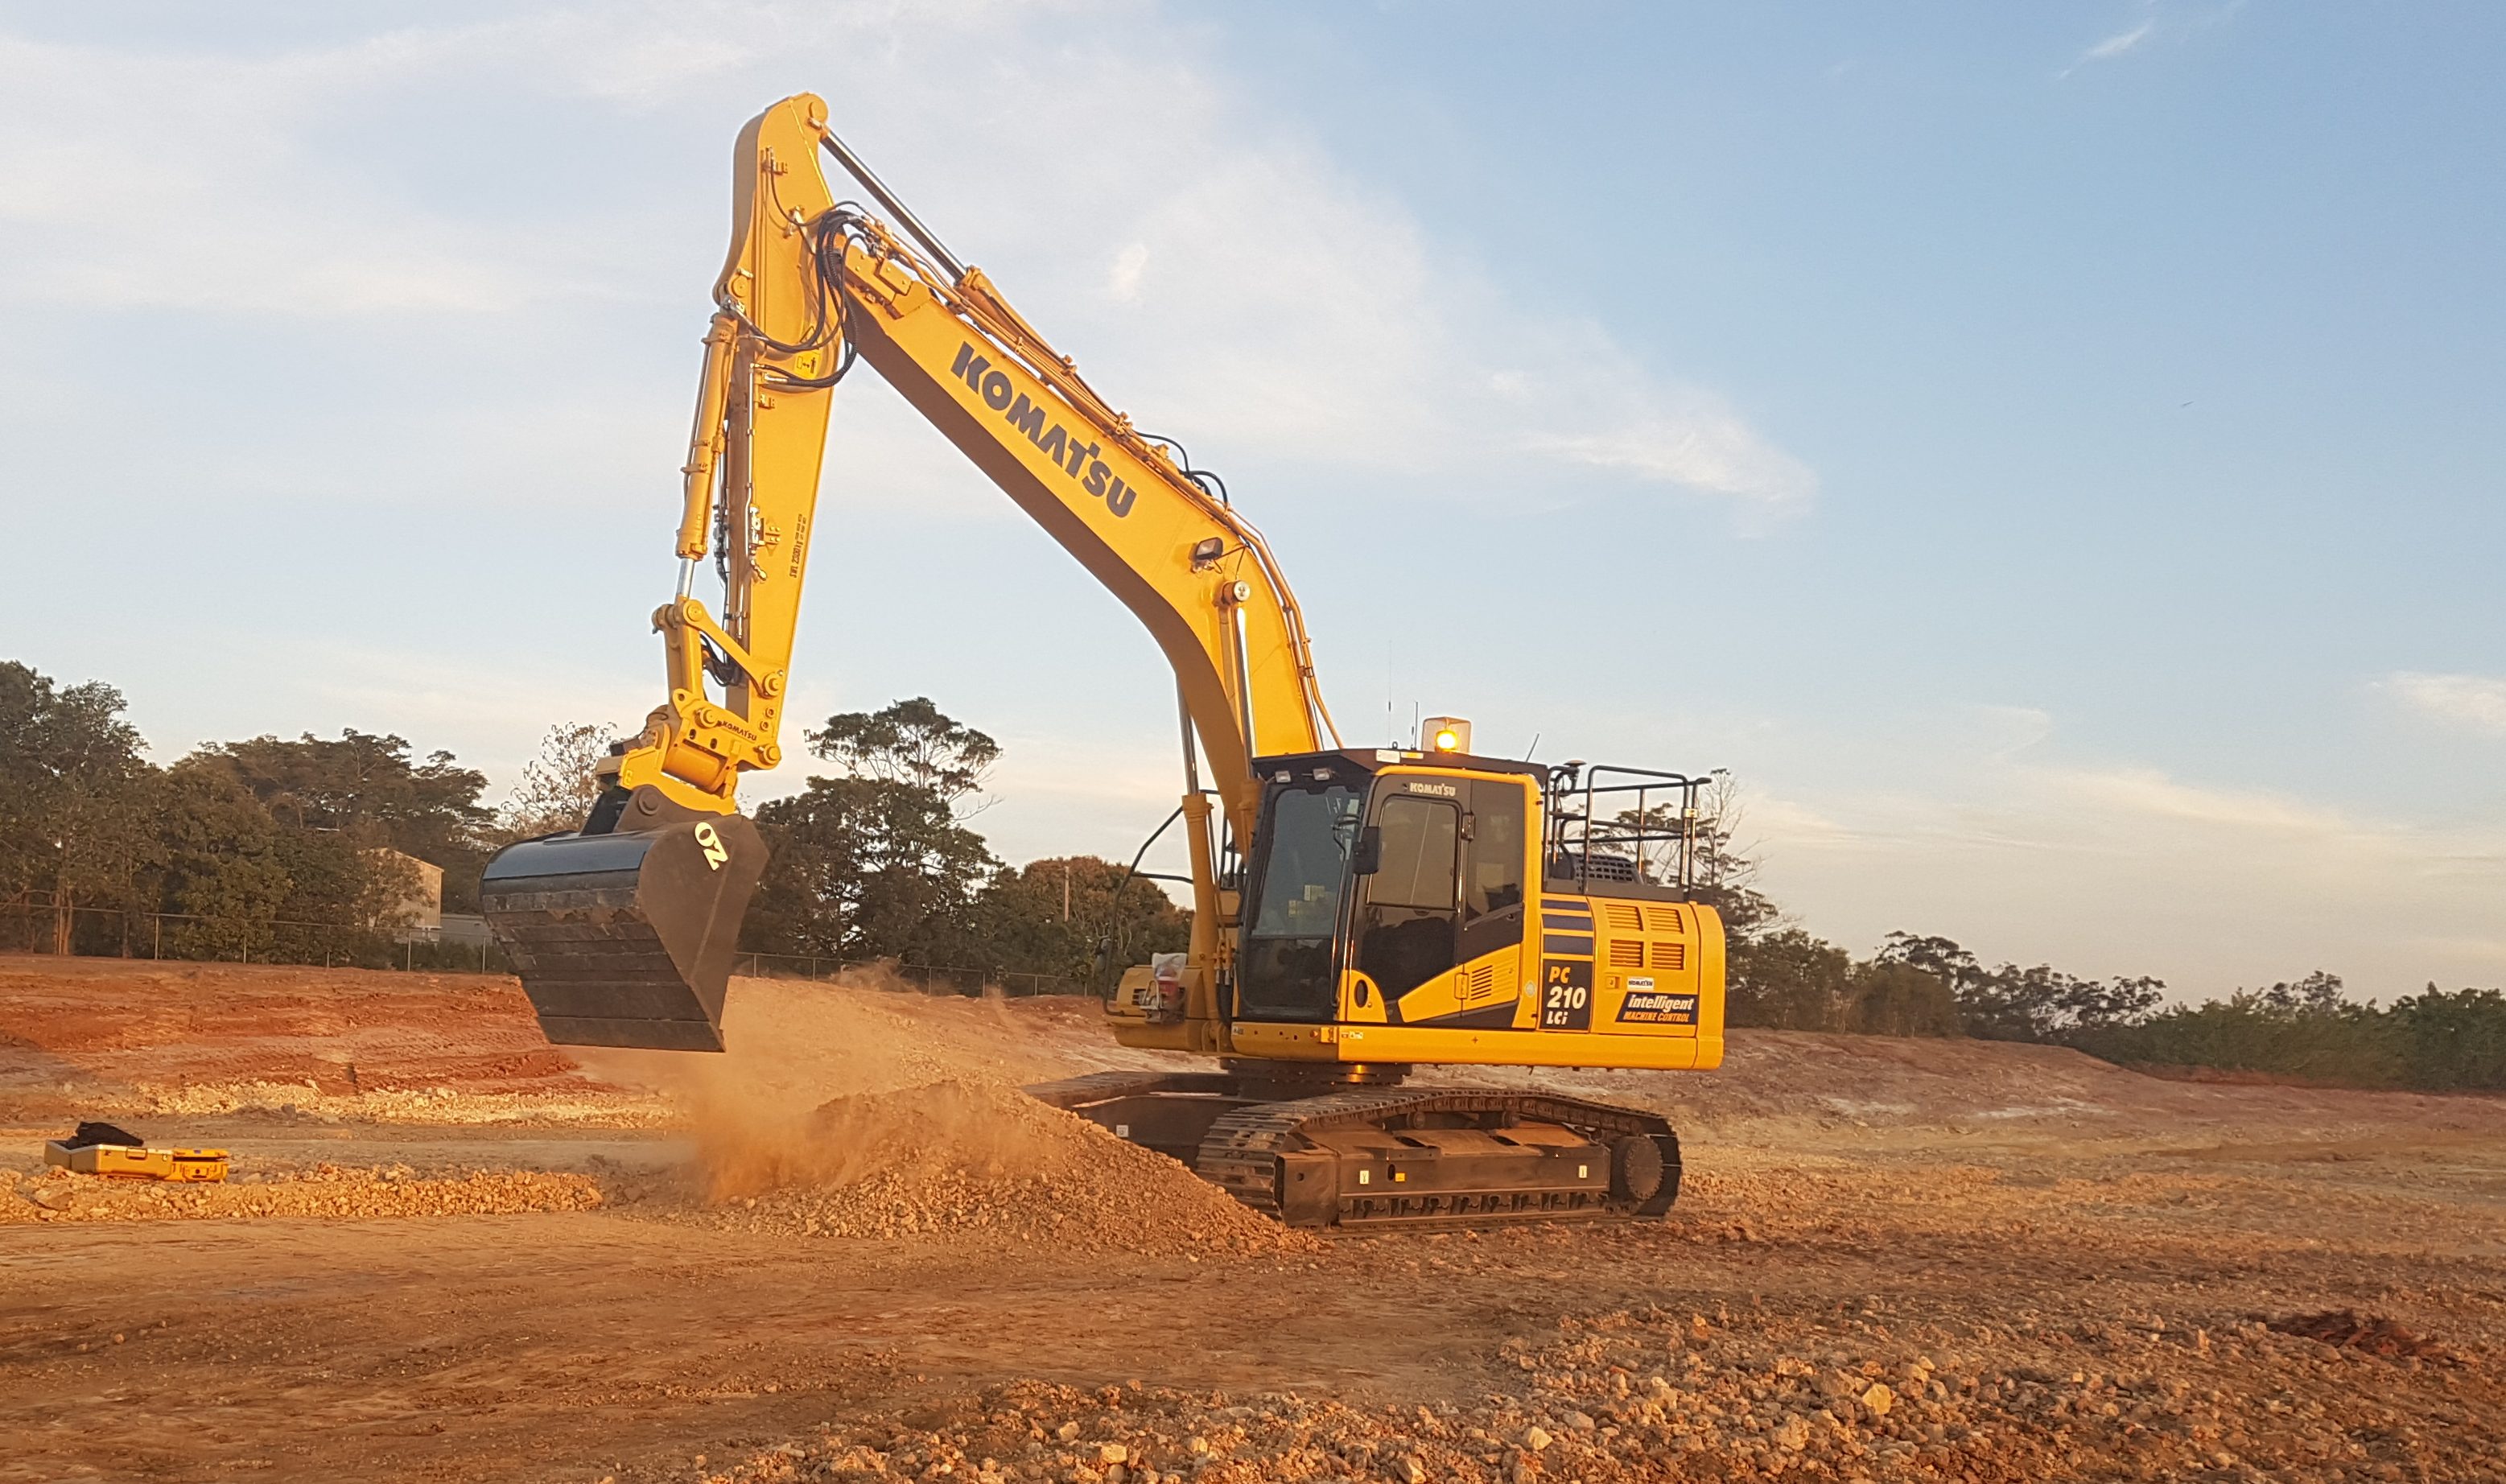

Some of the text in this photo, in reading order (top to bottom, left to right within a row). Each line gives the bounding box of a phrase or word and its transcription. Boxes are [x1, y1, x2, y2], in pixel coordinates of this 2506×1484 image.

[950, 341, 1137, 517] KOMATSU
[723, 720, 757, 740] KOMATSU
[1410, 782, 1456, 797] KOMATSU
[1549, 967, 1571, 983] PC
[1547, 986, 1586, 1009] 210
[1628, 994, 1695, 1012] intelligent
[1546, 1011, 1568, 1024] LCi
[1623, 1012, 1690, 1022] MACHINE CONTROL
